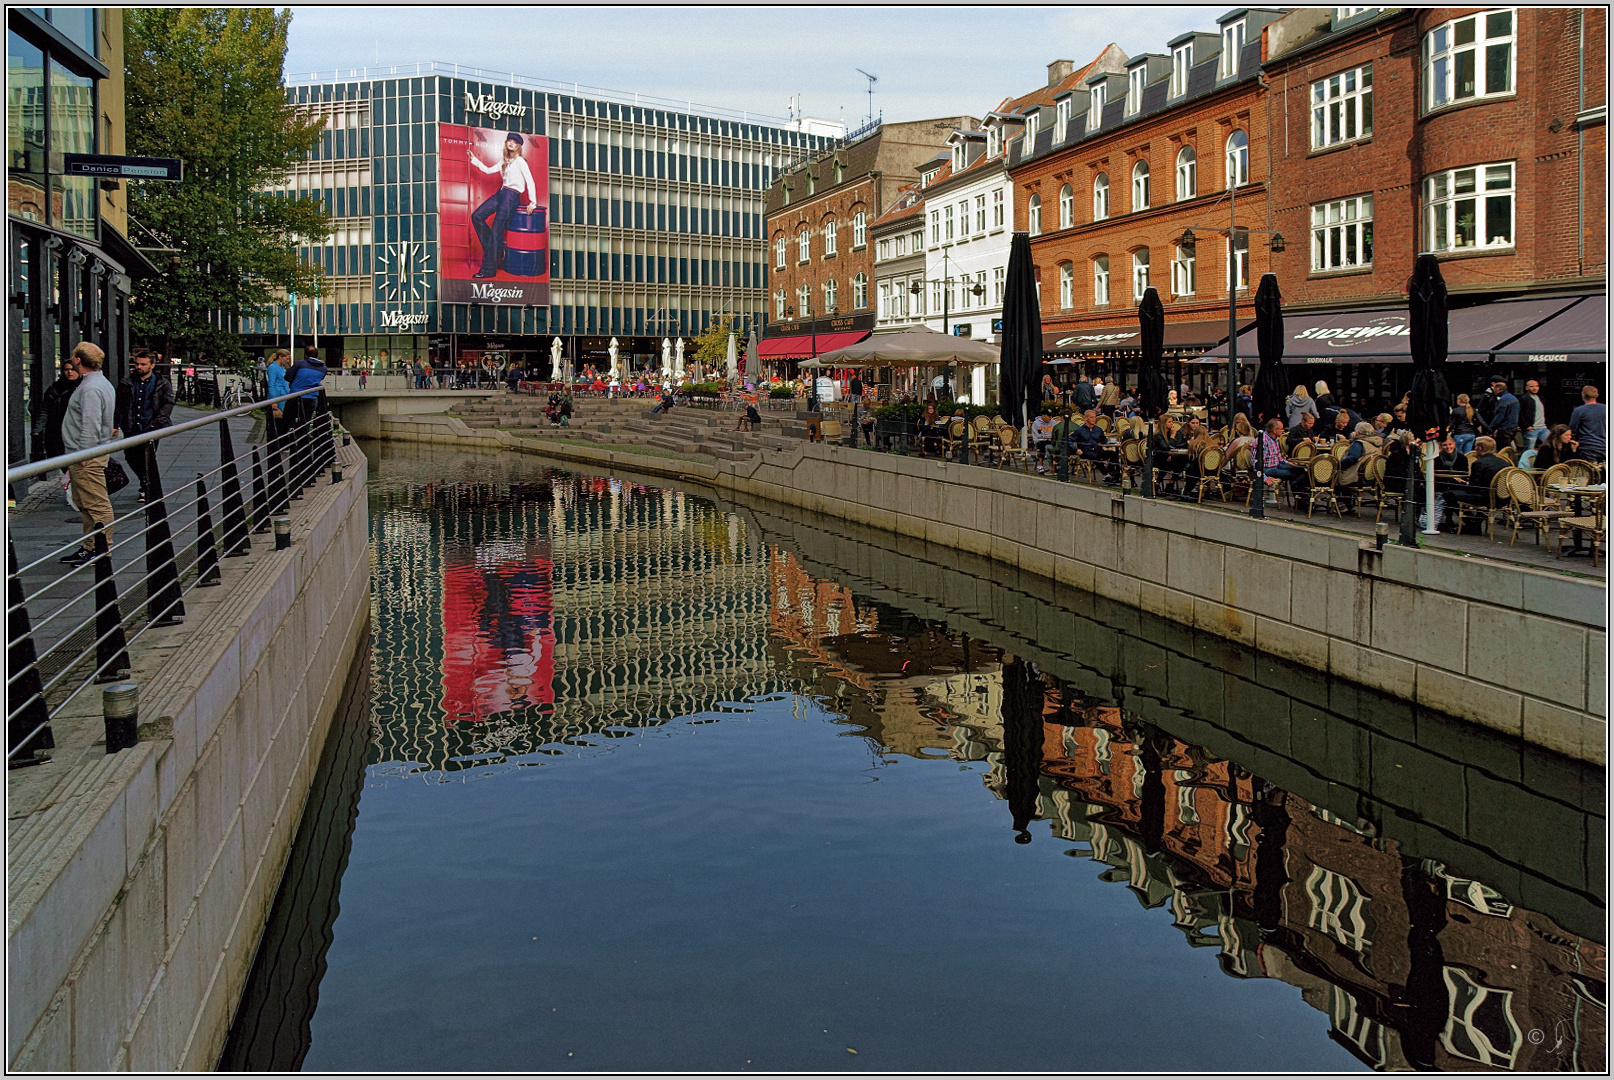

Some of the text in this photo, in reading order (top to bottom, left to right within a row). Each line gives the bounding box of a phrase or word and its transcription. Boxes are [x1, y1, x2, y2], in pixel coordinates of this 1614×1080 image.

[464, 92, 527, 120] Magasin
[82, 165, 166, 175] Danica Pension
[471, 282, 524, 302] Magasin
[380, 310, 429, 330] Magasin
[1294, 324, 1410, 340] SIDEWAL
[1528, 354, 1567, 362] PASCUCCI
